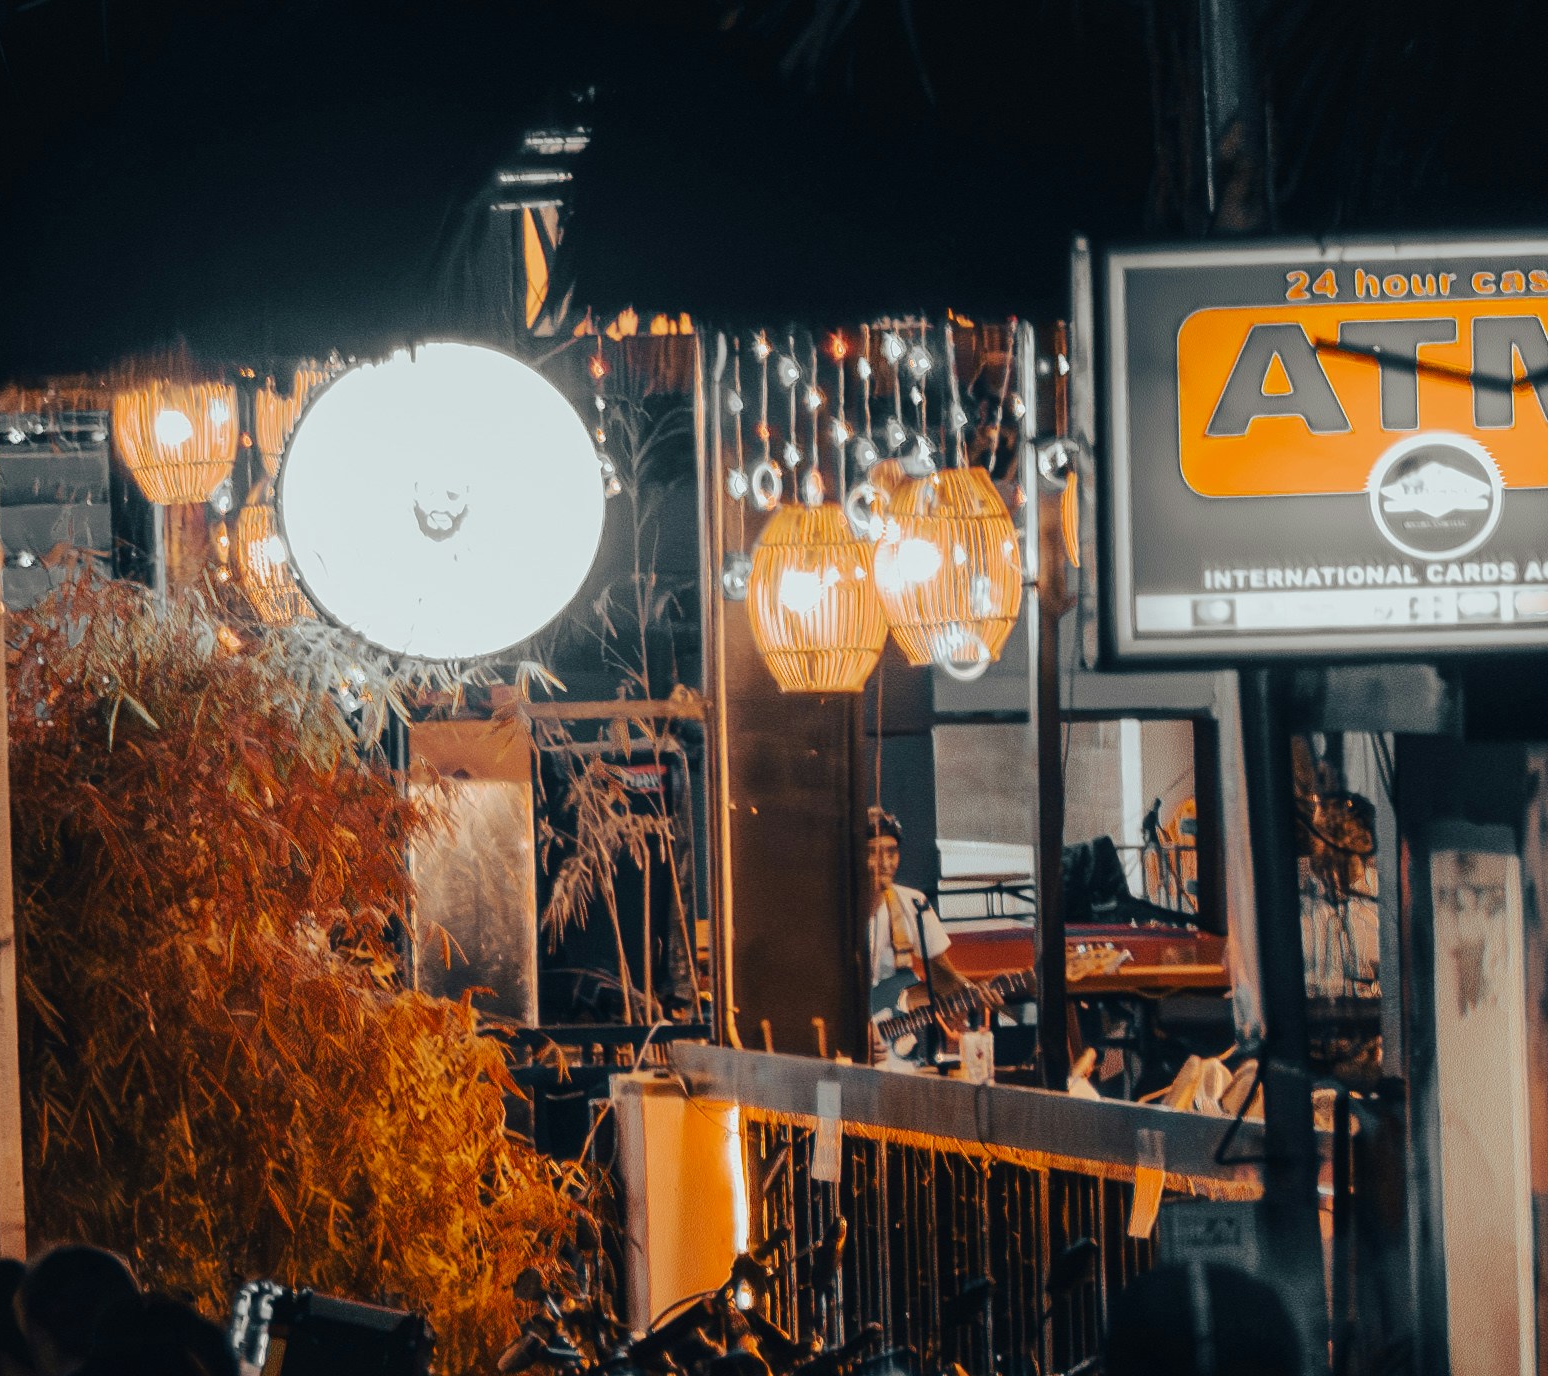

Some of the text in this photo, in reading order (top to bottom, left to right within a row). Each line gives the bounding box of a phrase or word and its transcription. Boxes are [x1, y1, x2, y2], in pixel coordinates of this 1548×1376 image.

[1285, 268, 1339, 302] 24
[1354, 267, 1457, 299] hour
[1203, 564, 1419, 590] INTERNATIONAL
[1426, 561, 1517, 585] CARDS
